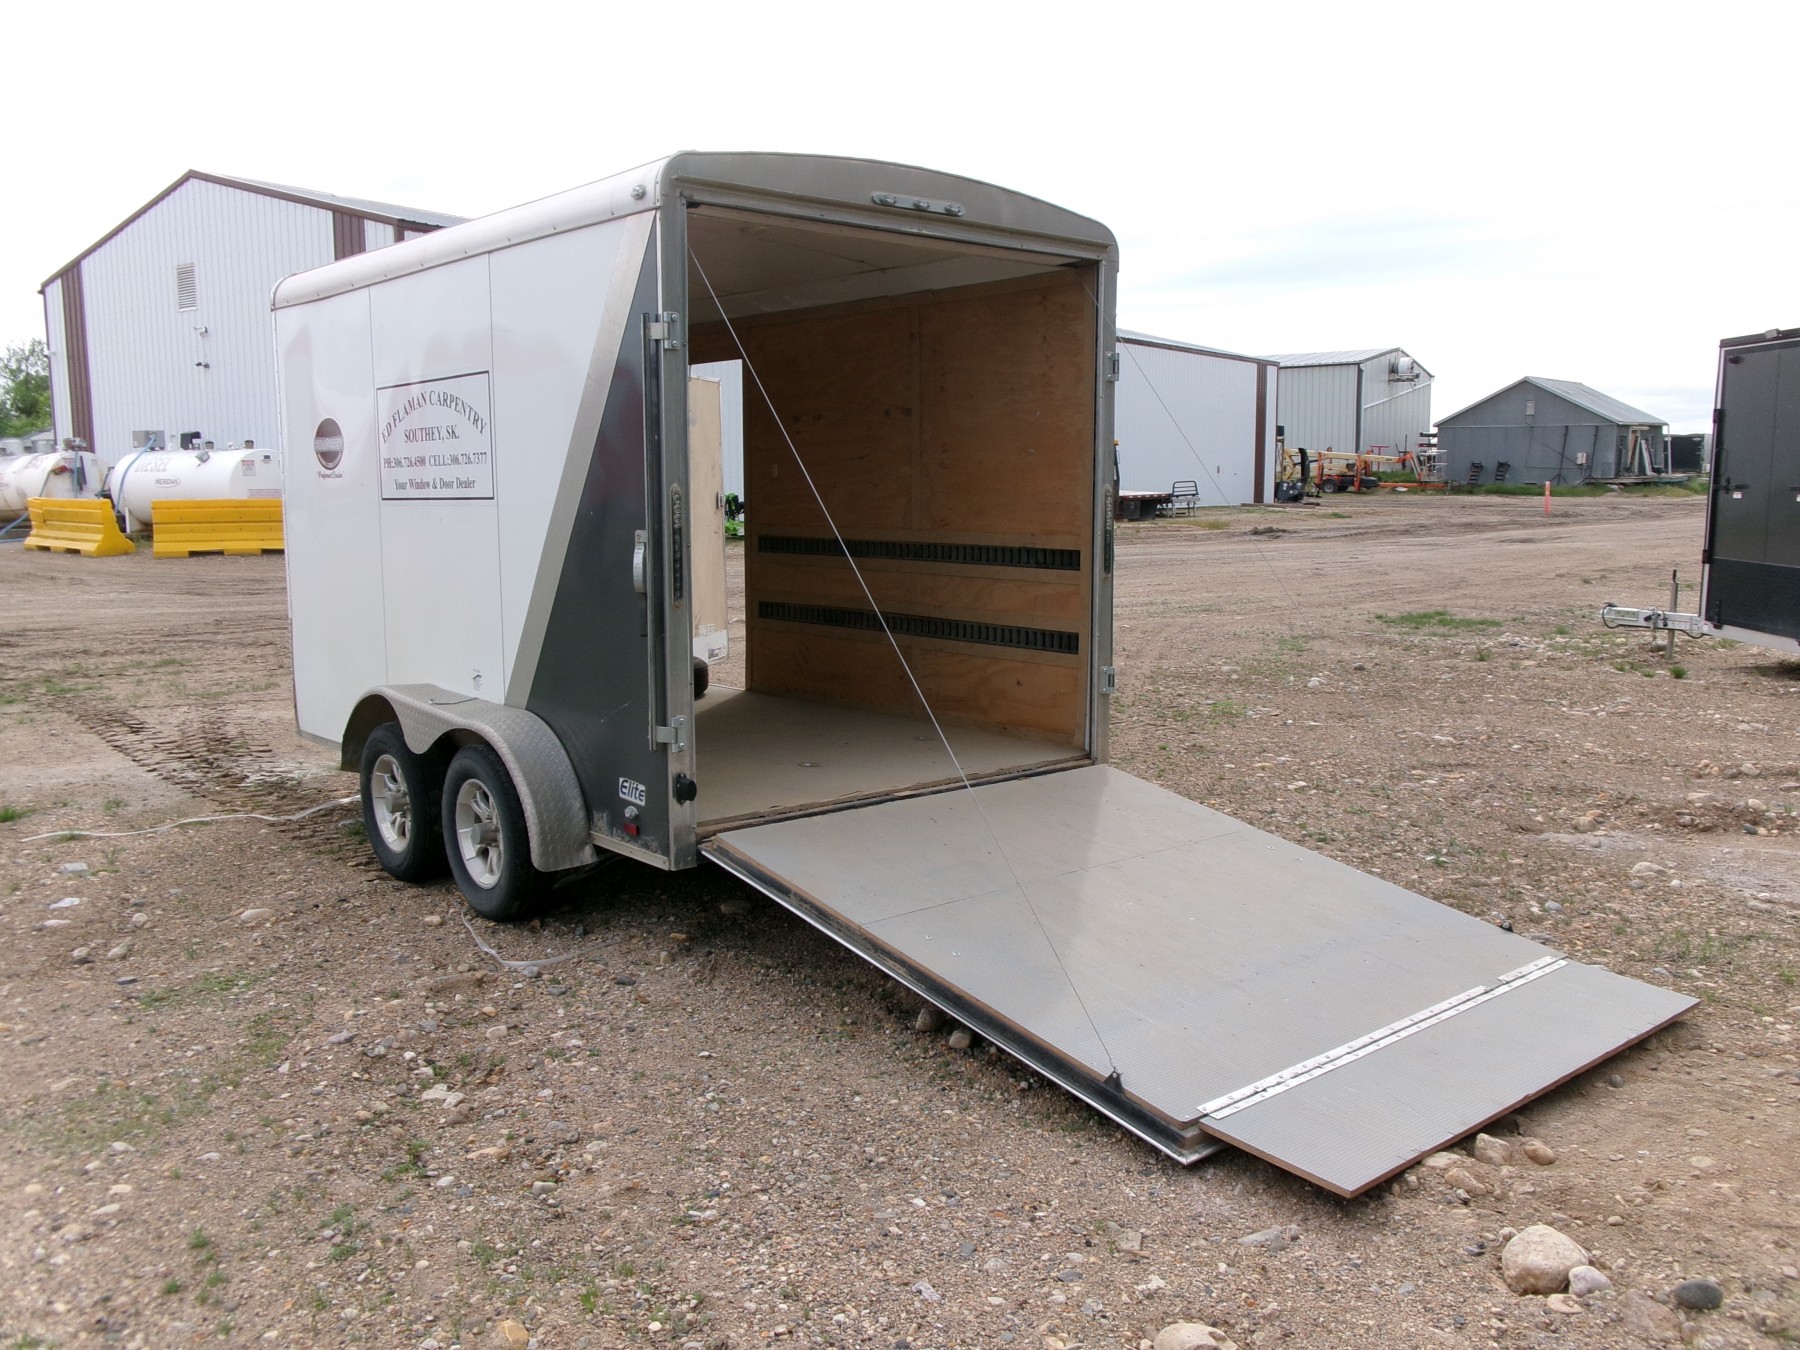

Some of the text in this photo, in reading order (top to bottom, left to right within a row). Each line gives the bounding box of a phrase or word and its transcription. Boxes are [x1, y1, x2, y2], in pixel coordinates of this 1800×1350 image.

[381, 390, 487, 444] ED FLAMAN CARPENTRY
[404, 424, 460, 444] SOUTHEY, SK.
[394, 476, 476, 491] Your Window & Door Dealer
[620, 779, 645, 802] Elite
